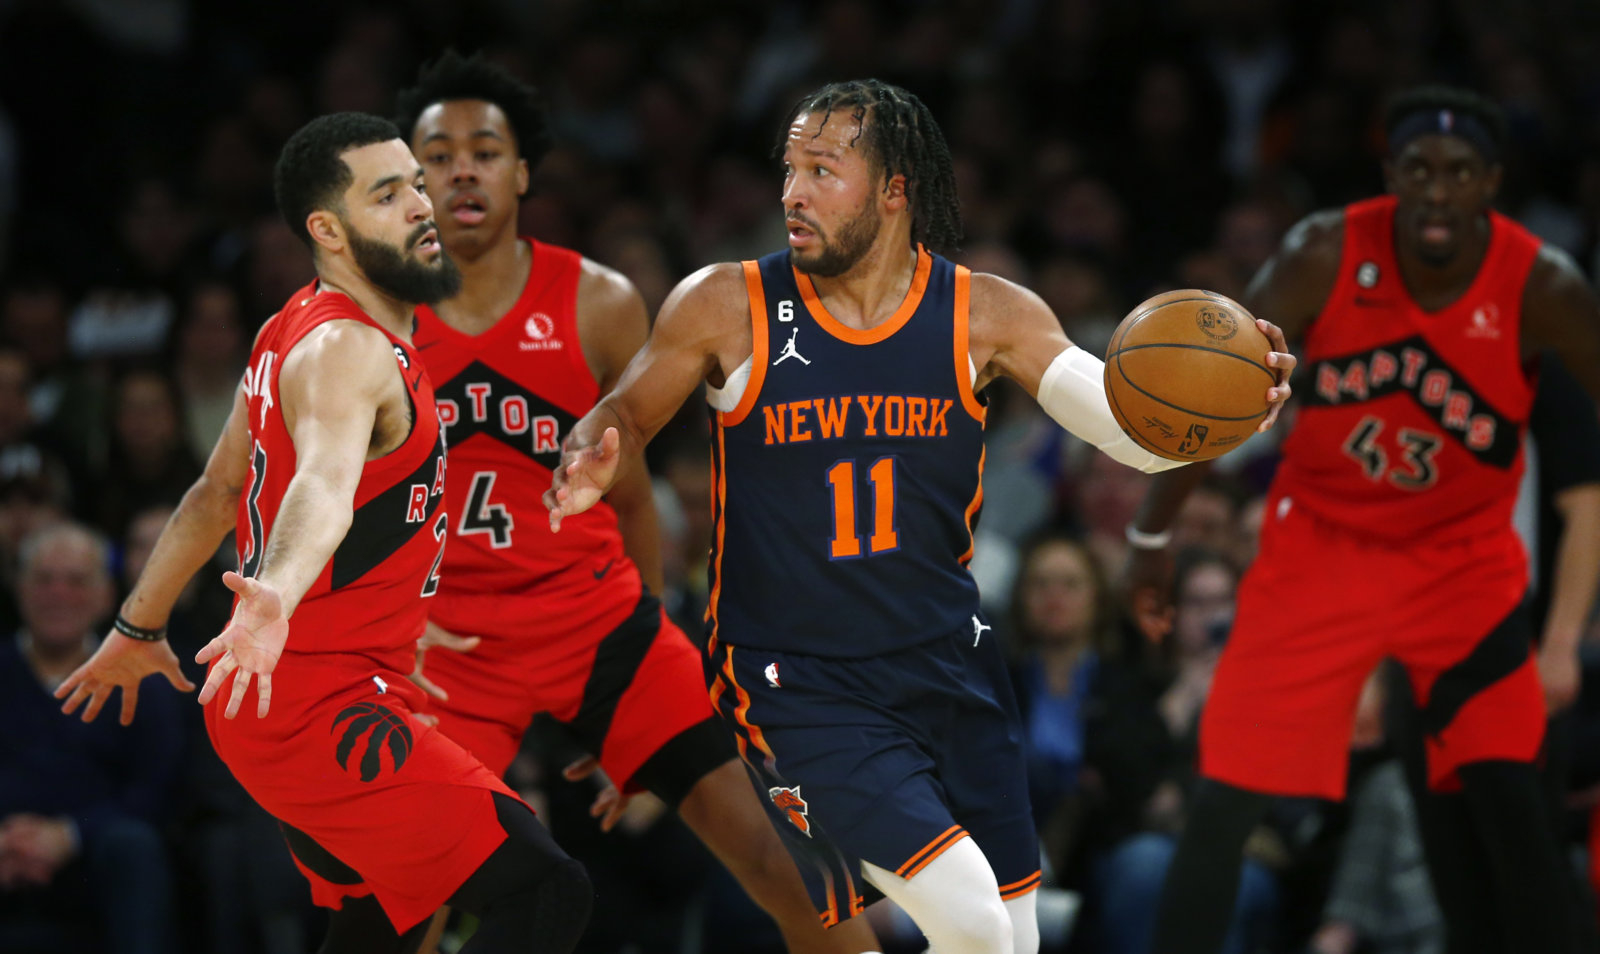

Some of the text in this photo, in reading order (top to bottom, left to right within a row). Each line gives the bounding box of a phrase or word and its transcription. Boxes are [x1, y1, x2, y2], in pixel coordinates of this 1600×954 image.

[777, 300, 794, 322] 6
[436, 382, 565, 454] PTOR
[763, 395, 954, 445] NEW YORK
[1315, 346, 1497, 451] RAPTORS
[405, 454, 448, 524] RA
[1340, 413, 1444, 491] 43
[457, 471, 515, 549] 4
[825, 454, 901, 562] 11
